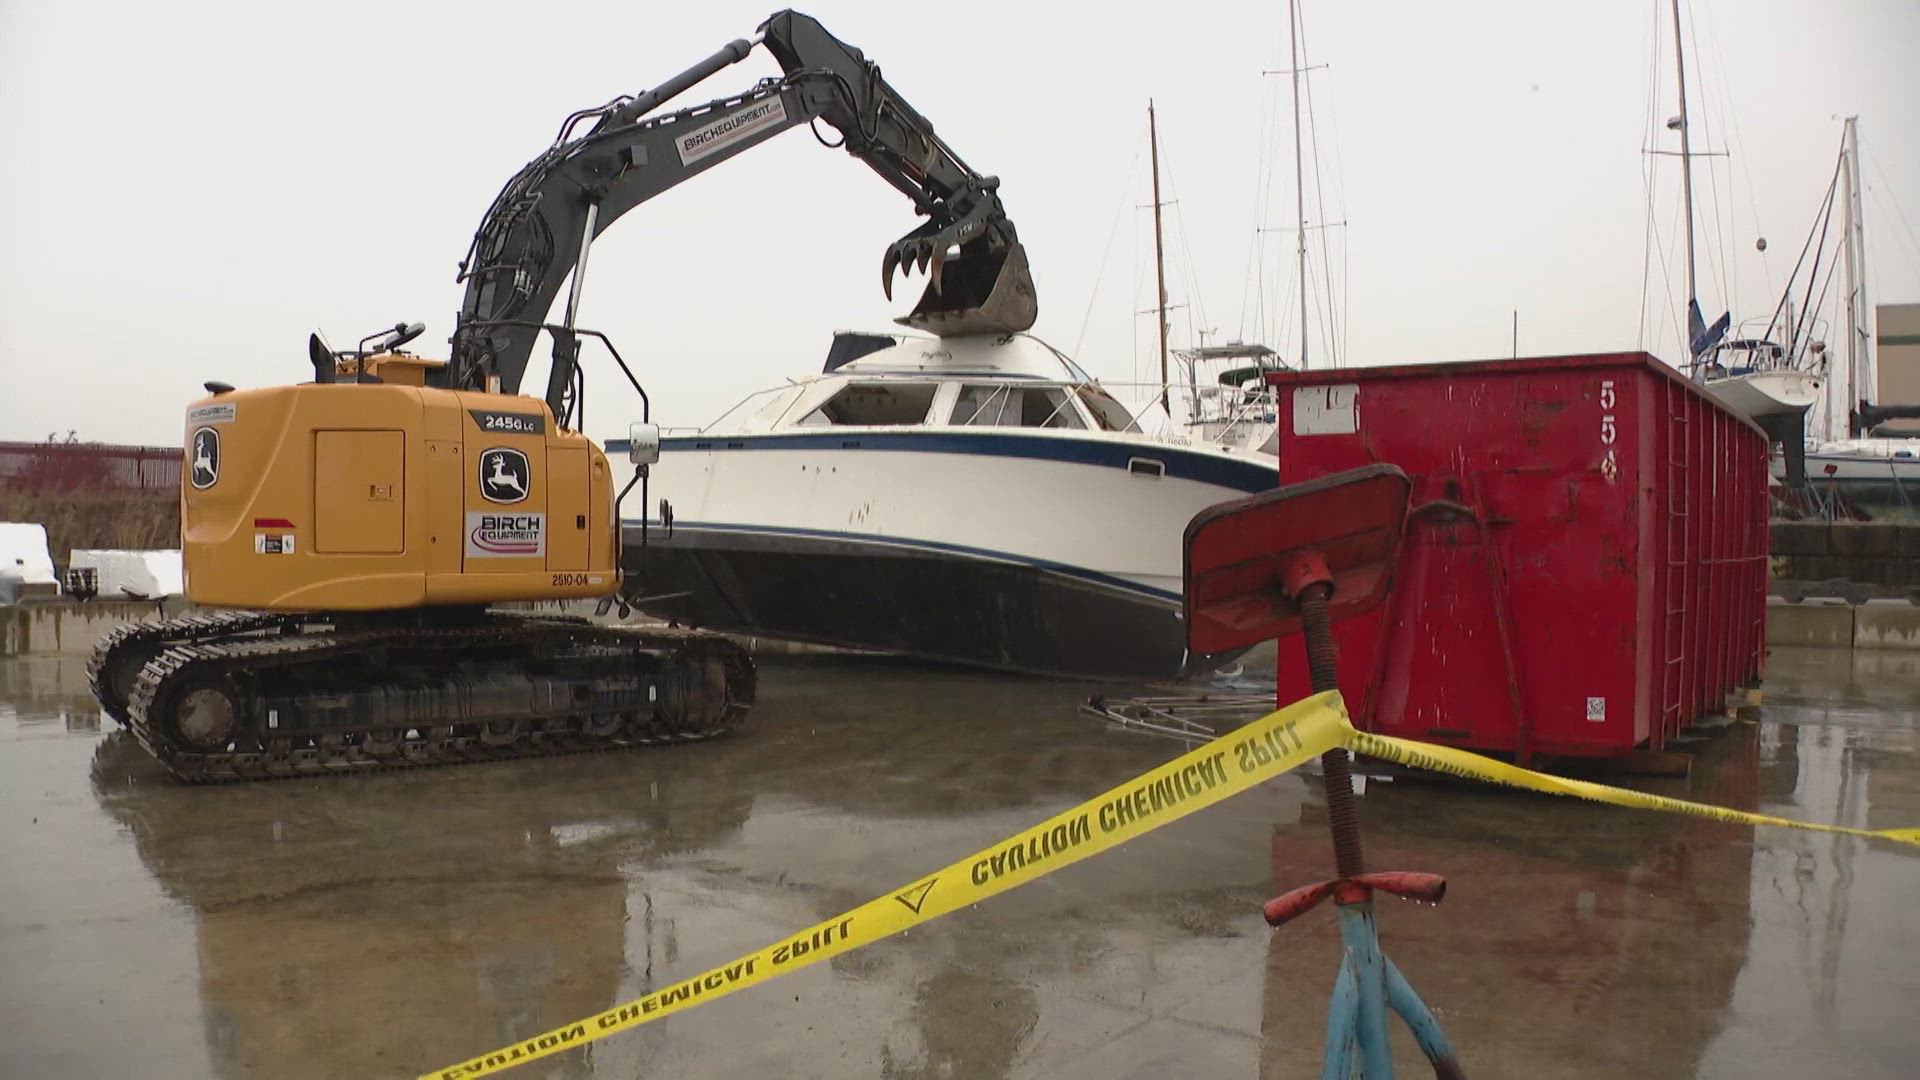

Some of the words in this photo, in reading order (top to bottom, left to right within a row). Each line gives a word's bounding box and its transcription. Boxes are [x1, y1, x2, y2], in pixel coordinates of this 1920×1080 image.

[481, 516, 539, 530] BIRCH
[482, 531, 539, 541] EQUIPMENT
[552, 573, 588, 586] 2510-04
